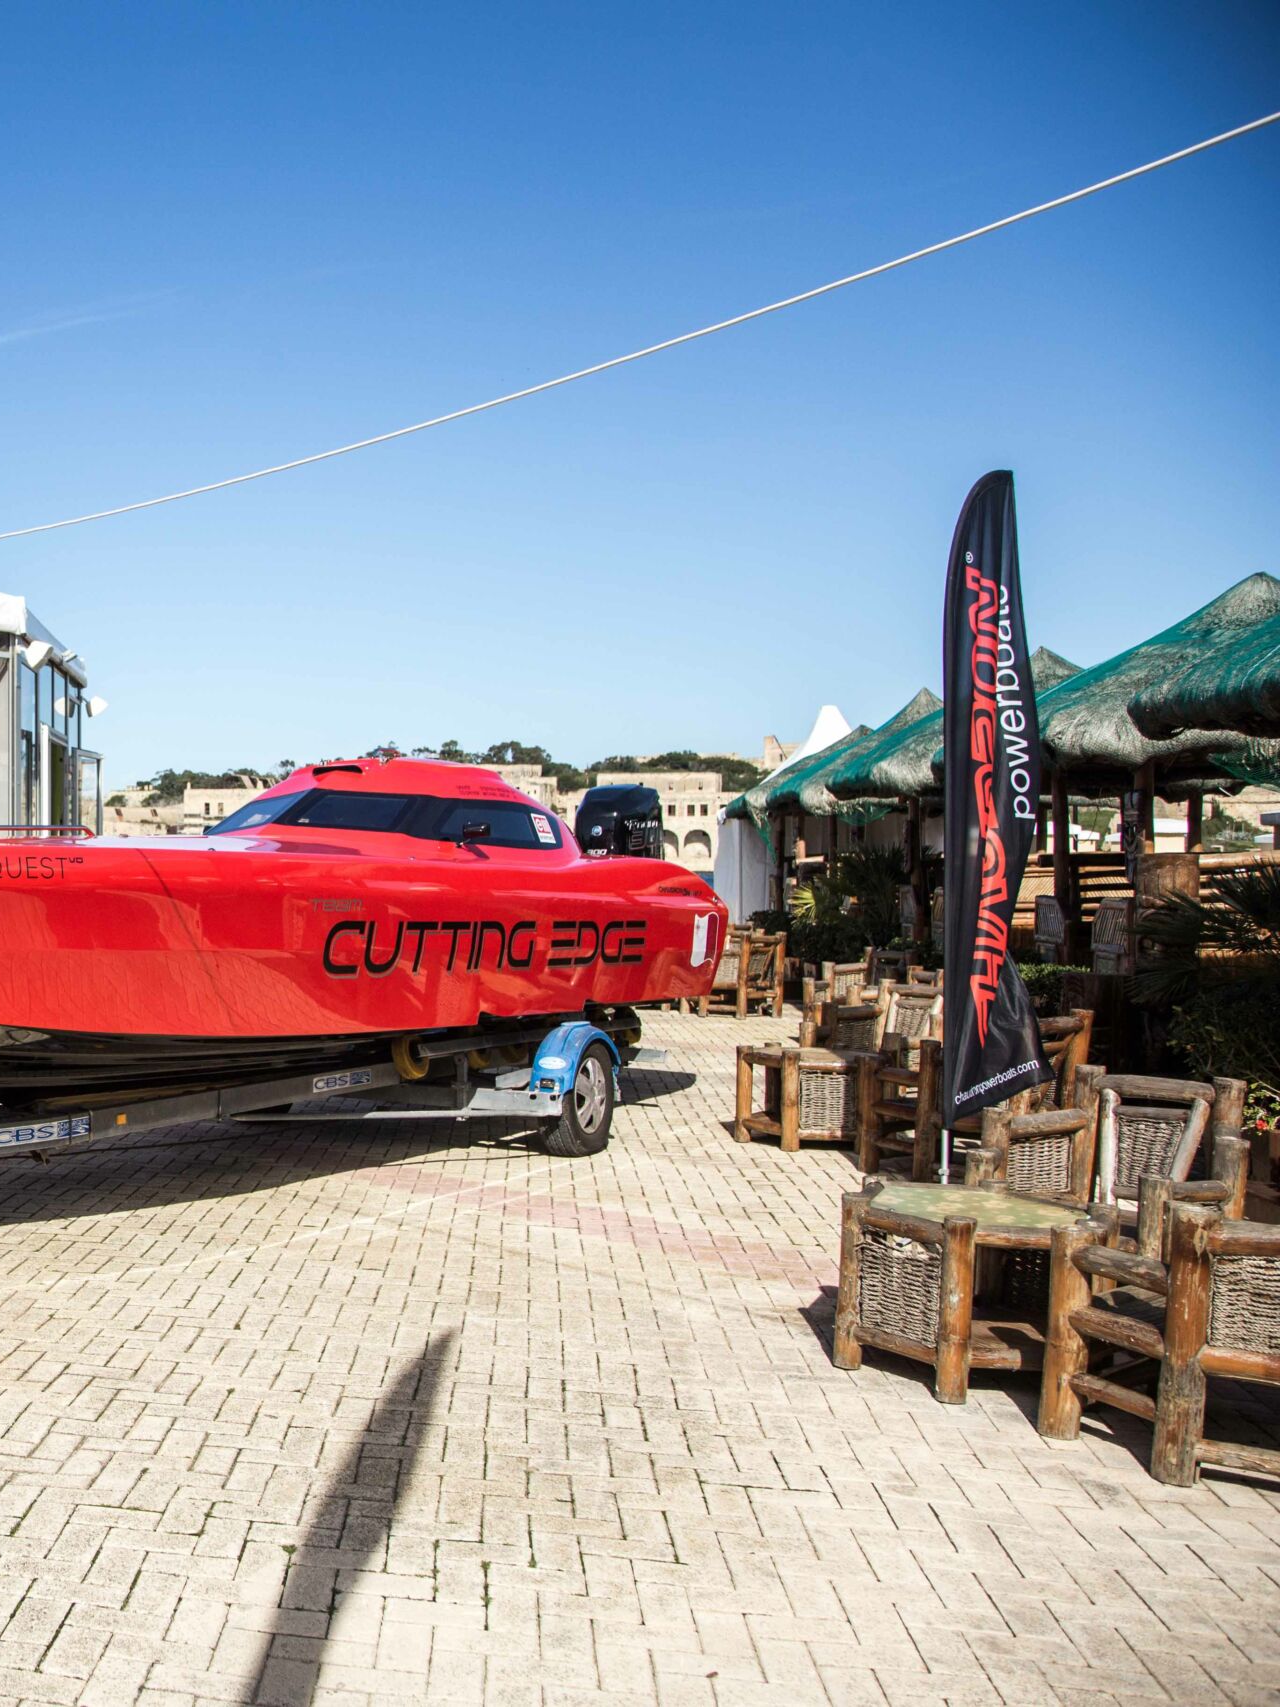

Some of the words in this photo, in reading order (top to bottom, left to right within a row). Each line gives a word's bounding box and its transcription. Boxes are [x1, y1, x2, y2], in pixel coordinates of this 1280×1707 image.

[323, 920, 539, 979] CUTTING
[546, 919, 647, 966] EDGE
[314, 1075, 349, 1091] CBS
